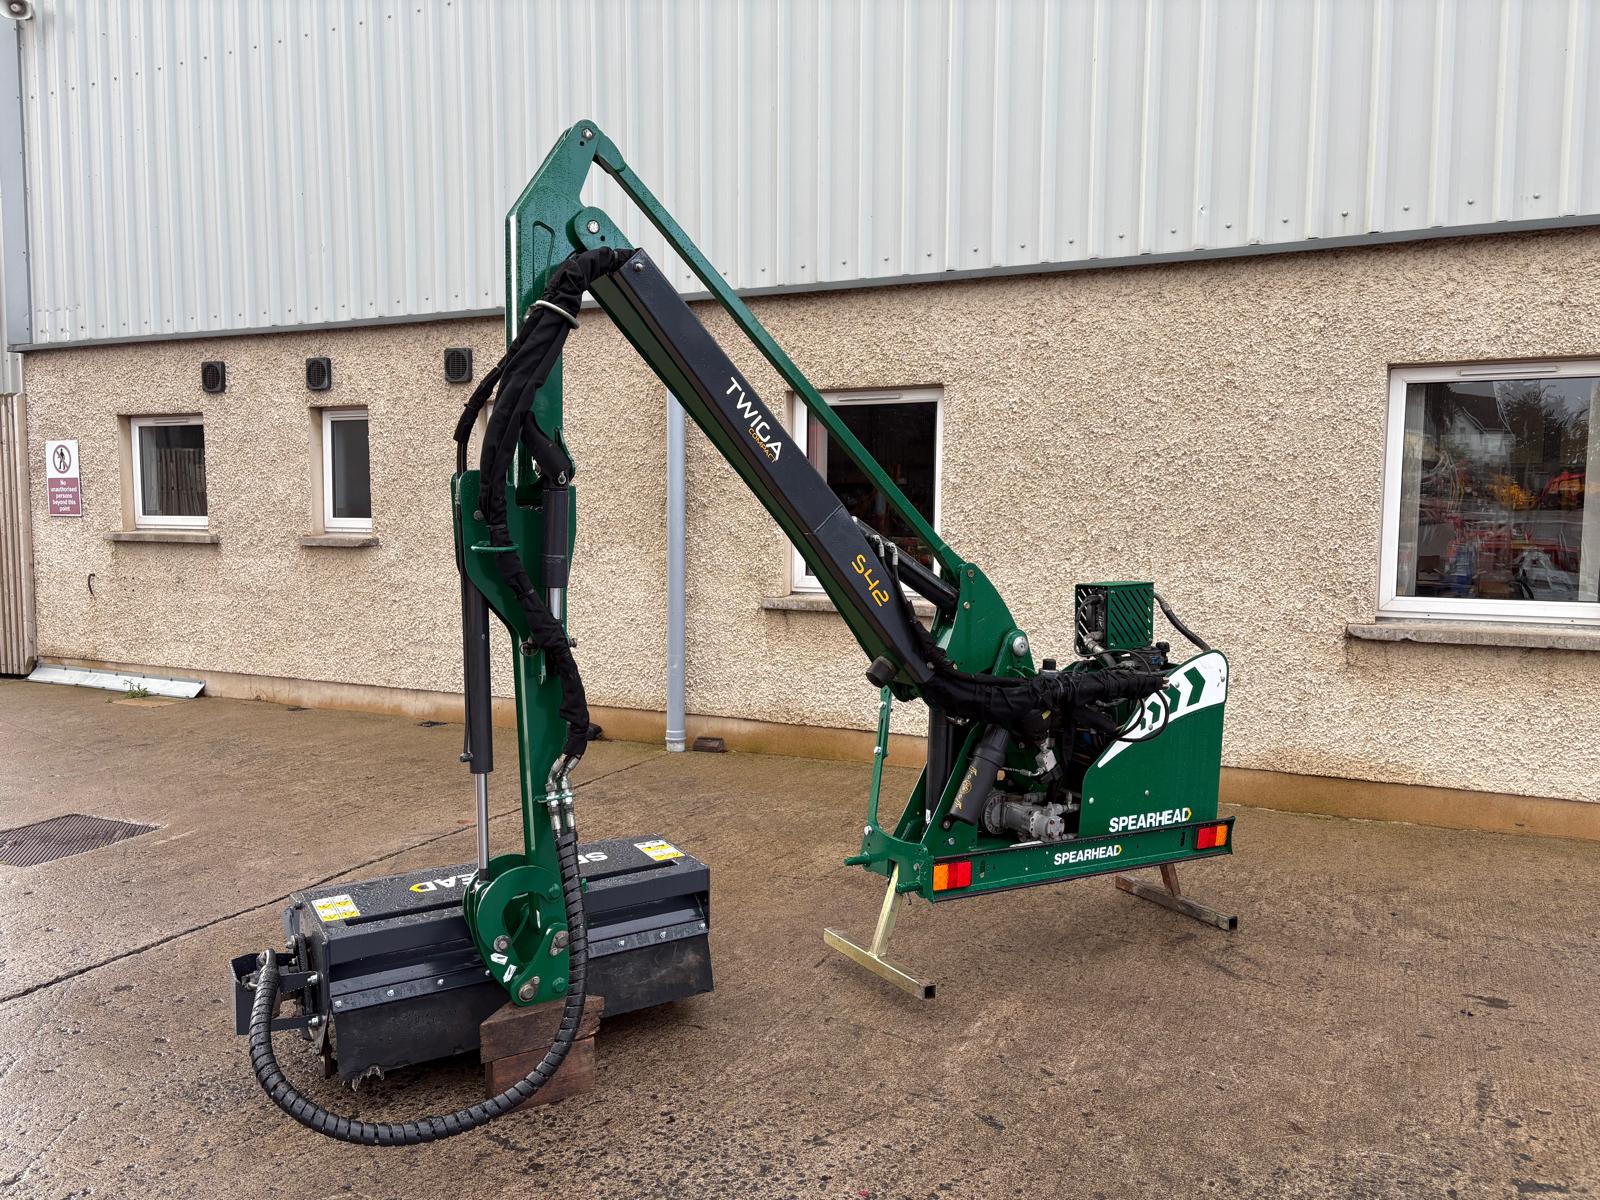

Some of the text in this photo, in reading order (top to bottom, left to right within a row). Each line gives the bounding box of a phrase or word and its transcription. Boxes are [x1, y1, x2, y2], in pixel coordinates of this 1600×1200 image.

[726, 377, 781, 461] TWIGA
[748, 428, 776, 463] COMPACT
[851, 554, 890, 607] S42
[1108, 807, 1192, 833] SPEARHEAD
[1053, 844, 1123, 866] SPEARHEAD
